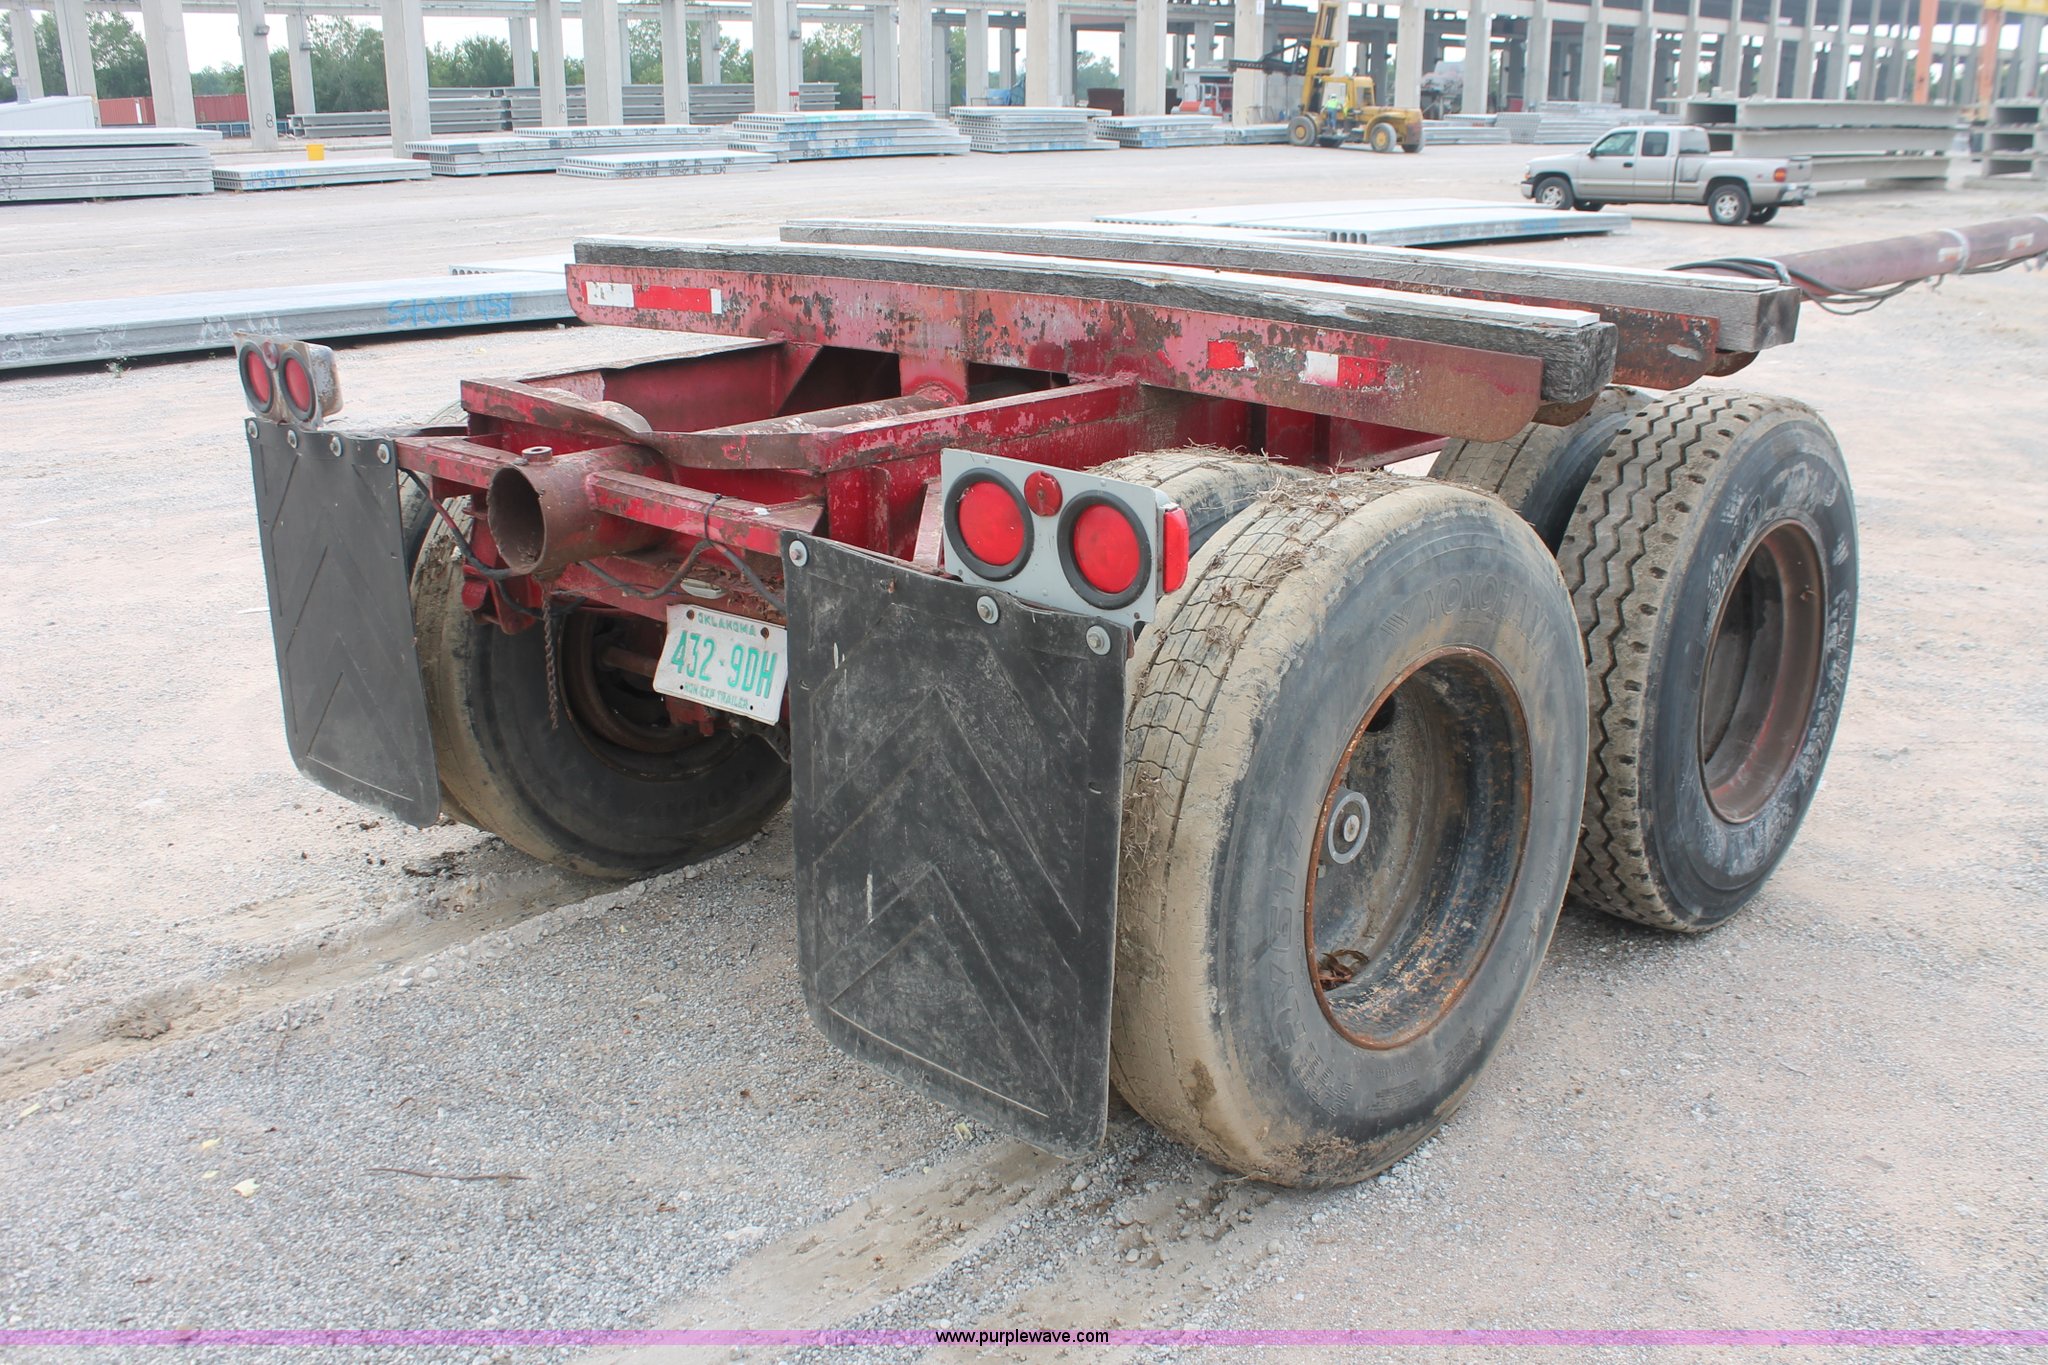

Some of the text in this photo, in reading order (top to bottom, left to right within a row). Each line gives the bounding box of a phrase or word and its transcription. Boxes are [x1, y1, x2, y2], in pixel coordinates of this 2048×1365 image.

[265, 112, 274, 129] 8
[387, 297, 469, 327] STOCK
[698, 612, 757, 637] OKLAHOMA
[717, 690, 749, 711] TRAILER
